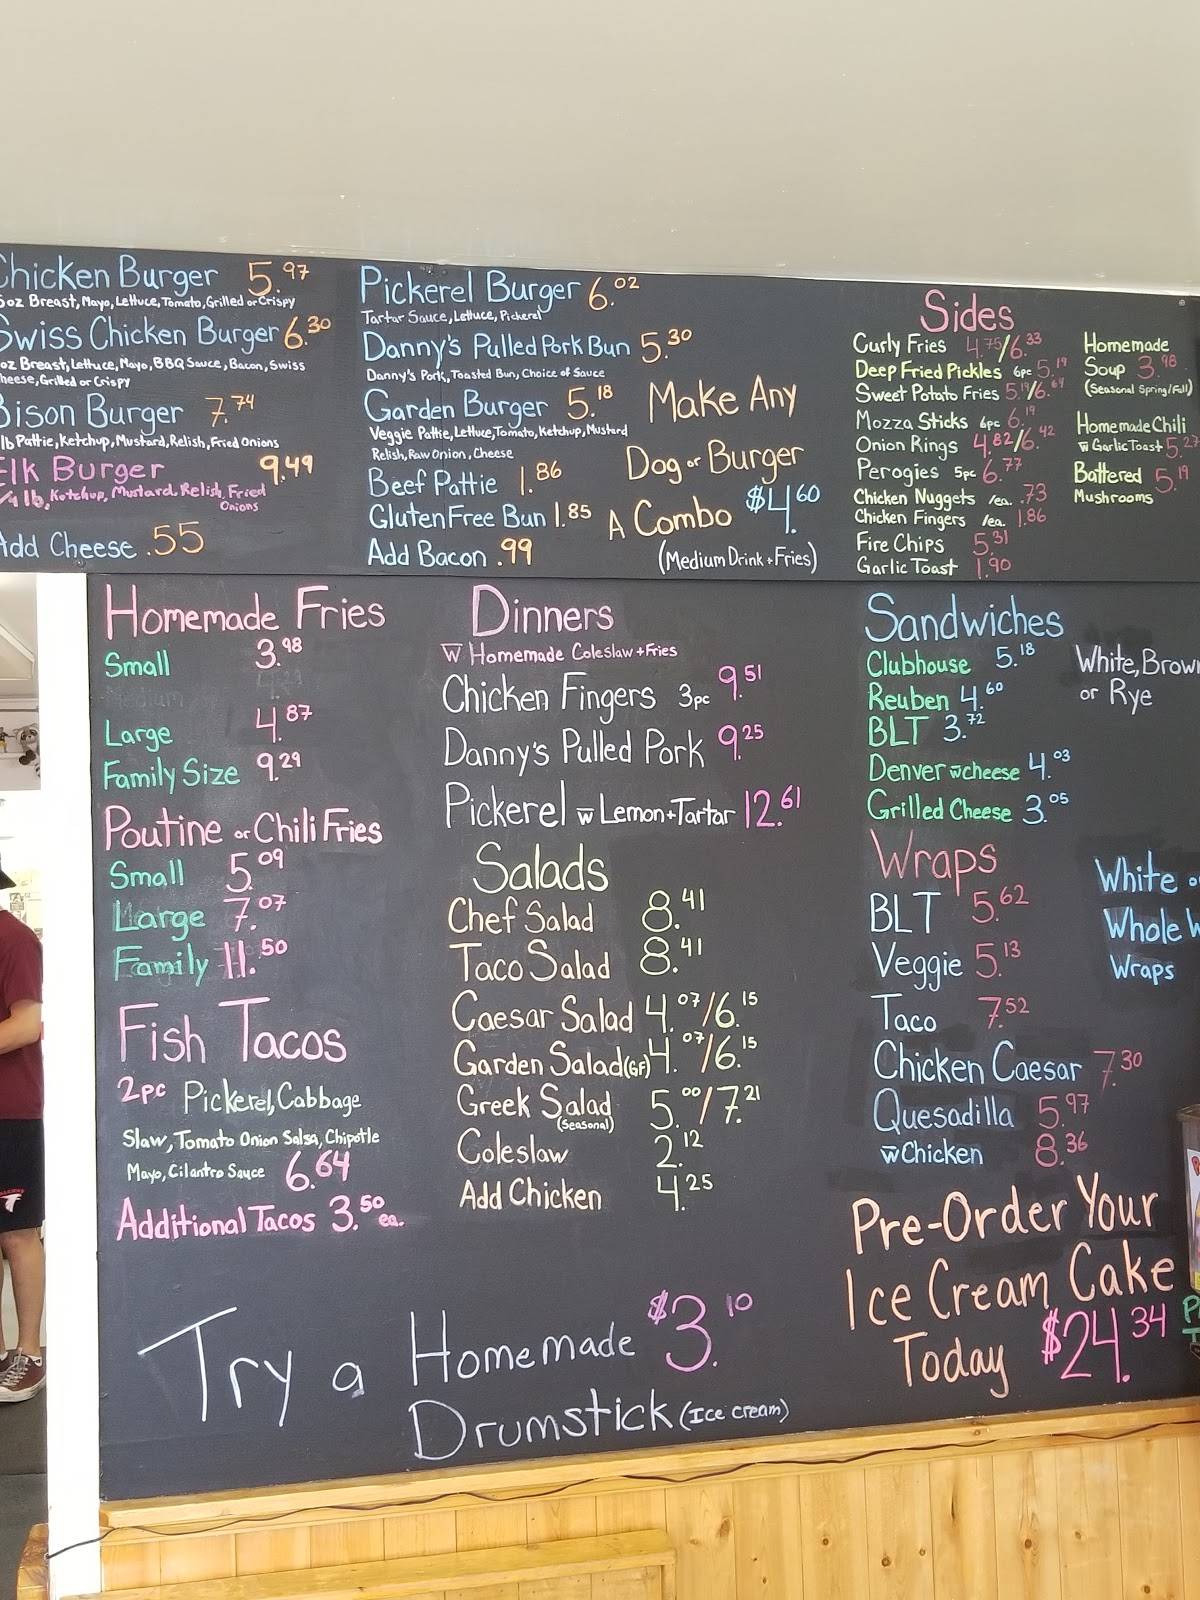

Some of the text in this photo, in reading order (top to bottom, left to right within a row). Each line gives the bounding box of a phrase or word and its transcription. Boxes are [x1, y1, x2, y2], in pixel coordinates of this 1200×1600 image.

[120, 255, 218, 298] Burger
[361, 266, 581, 314] Pickerel Burger
[206, 293, 295, 309] Grilled Crispy
[361, 310, 404, 324] Tartar
[920, 289, 1014, 332] Sides
[90, 316, 279, 354] Chicken Burger
[363, 331, 630, 369] Danny's Pulled Pork Bun
[853, 332, 946, 357] Curly Fries
[1085, 332, 1169, 353] Homemade
[153, 357, 305, 371] BBQ Swiss
[367, 367, 605, 383] Danny's Toasted Choice Sauce
[856, 360, 1031, 381] Deep Fried Pickles 6pc
[1085, 356, 1125, 380] Soup
[40, 374, 130, 389] Grilled Crispy
[856, 383, 999, 403] Sweet Potato Fries
[87, 393, 183, 437] Burger
[364, 389, 548, 430] Garden Burger
[650, 375, 796, 423] Make Any
[369, 424, 627, 446] Veggie Mustard
[857, 409, 1000, 431] Mozza Sticks 6pc
[1077, 411, 1186, 434] Homemade Chili
[211, 437, 279, 448] Fried Onions
[474, 447, 514, 459] Cheese
[856, 435, 958, 461] Onion Rings
[53, 456, 164, 489] Burger
[627, 439, 804, 484] Dog Burger
[857, 457, 976, 487] Perogies 5pc
[1074, 461, 1142, 484] Battered
[369, 467, 497, 497] Beef Pattie
[1074, 489, 1153, 504] Mushrooms
[503, 504, 546, 528] Bun
[634, 496, 732, 536] Combo
[854, 488, 907, 505] Chicken
[914, 488, 975, 512] Nuggets
[855, 508, 965, 531] Chicken Fingers
[50, 531, 137, 559] Cheese
[368, 538, 409, 565] Add
[418, 540, 486, 567] Bacon
[728, 546, 764, 566] Drink
[857, 531, 944, 558] Fire Chips
[857, 556, 907, 574] Garlic
[910, 558, 958, 575] Toast
[107, 584, 385, 640] Homemade Fries
[473, 584, 614, 636] Dinners
[865, 593, 1063, 642] Sandwiches
[105, 650, 169, 677] Small
[469, 642, 633, 665] Homemade Coleslaw
[867, 650, 971, 677] Clubhouse
[443, 672, 709, 724] Chicken Fingers 3pc
[868, 682, 949, 711] Reuben
[1110, 678, 1152, 715] Rye
[106, 720, 173, 752] Large
[869, 716, 929, 747] BLT
[444, 727, 704, 776] Danny's Pulled Pork
[870, 753, 946, 781] Denver
[104, 757, 240, 794] Family Size
[446, 780, 565, 828] Pickerel
[868, 789, 1012, 822] Grilled Cheese
[104, 805, 382, 850] Poutine or Chili Fries
[110, 859, 183, 889] Small
[473, 842, 608, 893] Salads
[870, 829, 997, 897] Wraps
[1095, 850, 1178, 893] White
[448, 896, 593, 934] Chef Salad
[870, 892, 941, 933] BLT
[1103, 907, 1182, 944] Whole
[449, 939, 610, 981] Taco Salad
[872, 942, 963, 991] Veggie
[1110, 954, 1174, 985] Wraps
[452, 990, 632, 1033] Caesar Salad
[871, 993, 936, 1032] Taco
[120, 997, 346, 1063] Fish Tacos
[874, 1040, 1082, 1084] Chicken Caesar
[118, 1076, 166, 1104] 2pc
[457, 1083, 613, 1120] Greek Salad
[874, 1088, 1014, 1135] Quesadilla
[240, 1132, 278, 1147] Onion
[458, 1124, 570, 1164] Coleslaw
[228, 1163, 265, 1180] Sauce
[460, 1177, 601, 1210] Add Chicken
[117, 1197, 316, 1241] Additional Tacos
[852, 1172, 1158, 1254] Pre-Order Your
[846, 1240, 1174, 1330] Ice Cream Cake
[137, 1307, 292, 1427] Try
[411, 1310, 635, 1386] Homemade
[893, 1332, 1009, 1398] Today
[408, 1388, 673, 1461] Drumstick
